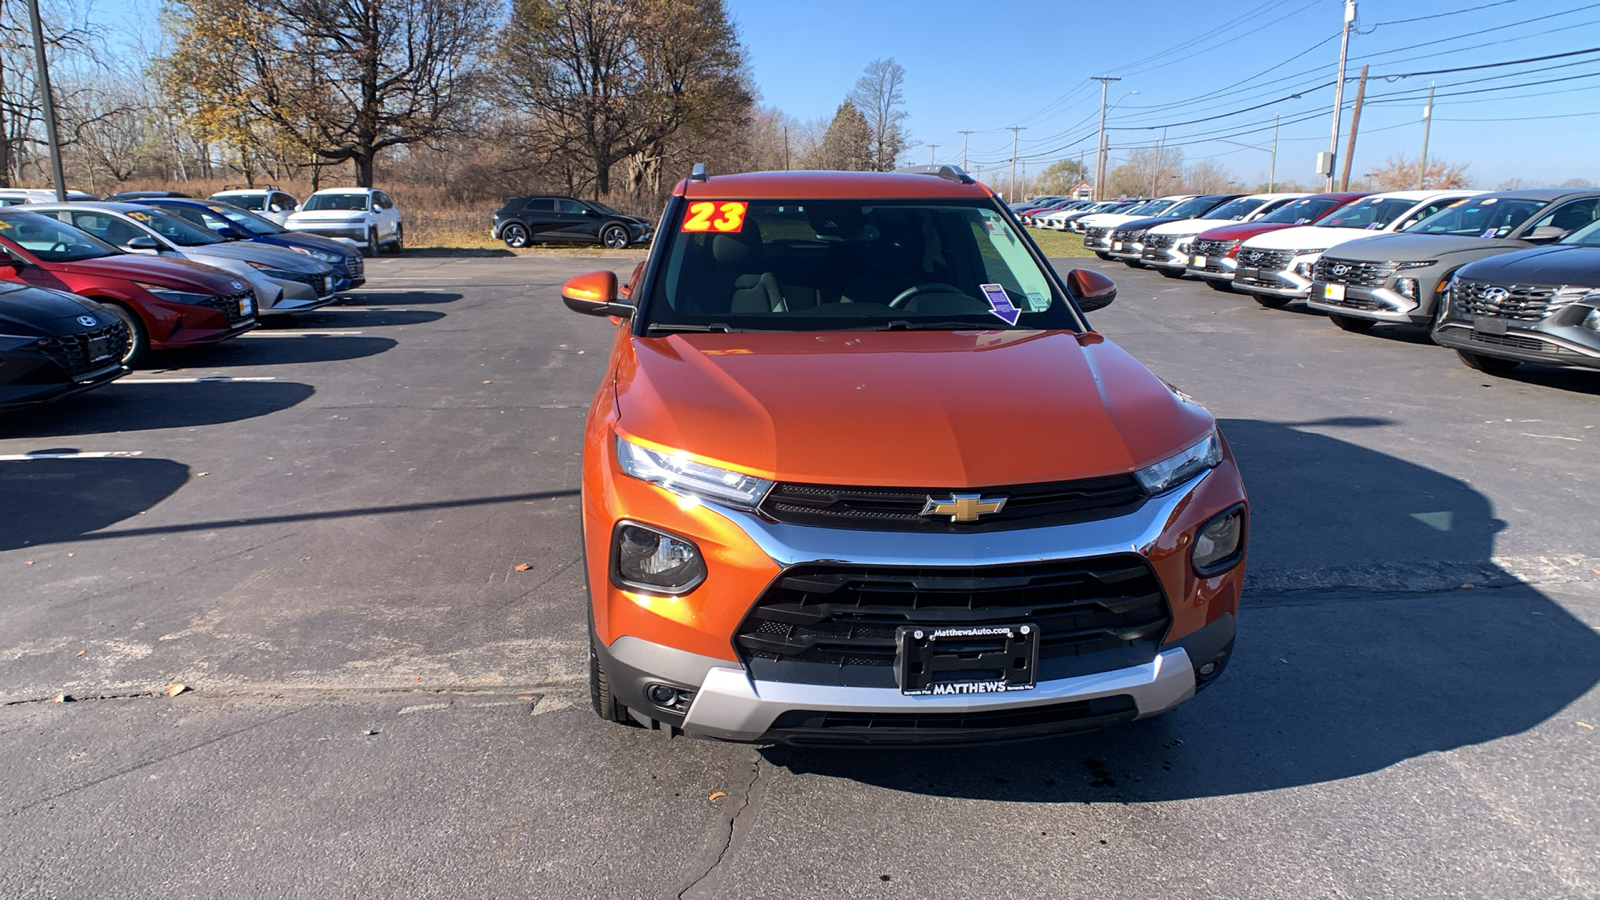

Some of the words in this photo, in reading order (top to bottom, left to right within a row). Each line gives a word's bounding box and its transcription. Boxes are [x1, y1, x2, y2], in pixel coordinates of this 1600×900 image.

[684, 202, 745, 231] 23
[934, 628, 1010, 637] MatthewsAuto.com
[933, 681, 1006, 695] MATTHEWS
